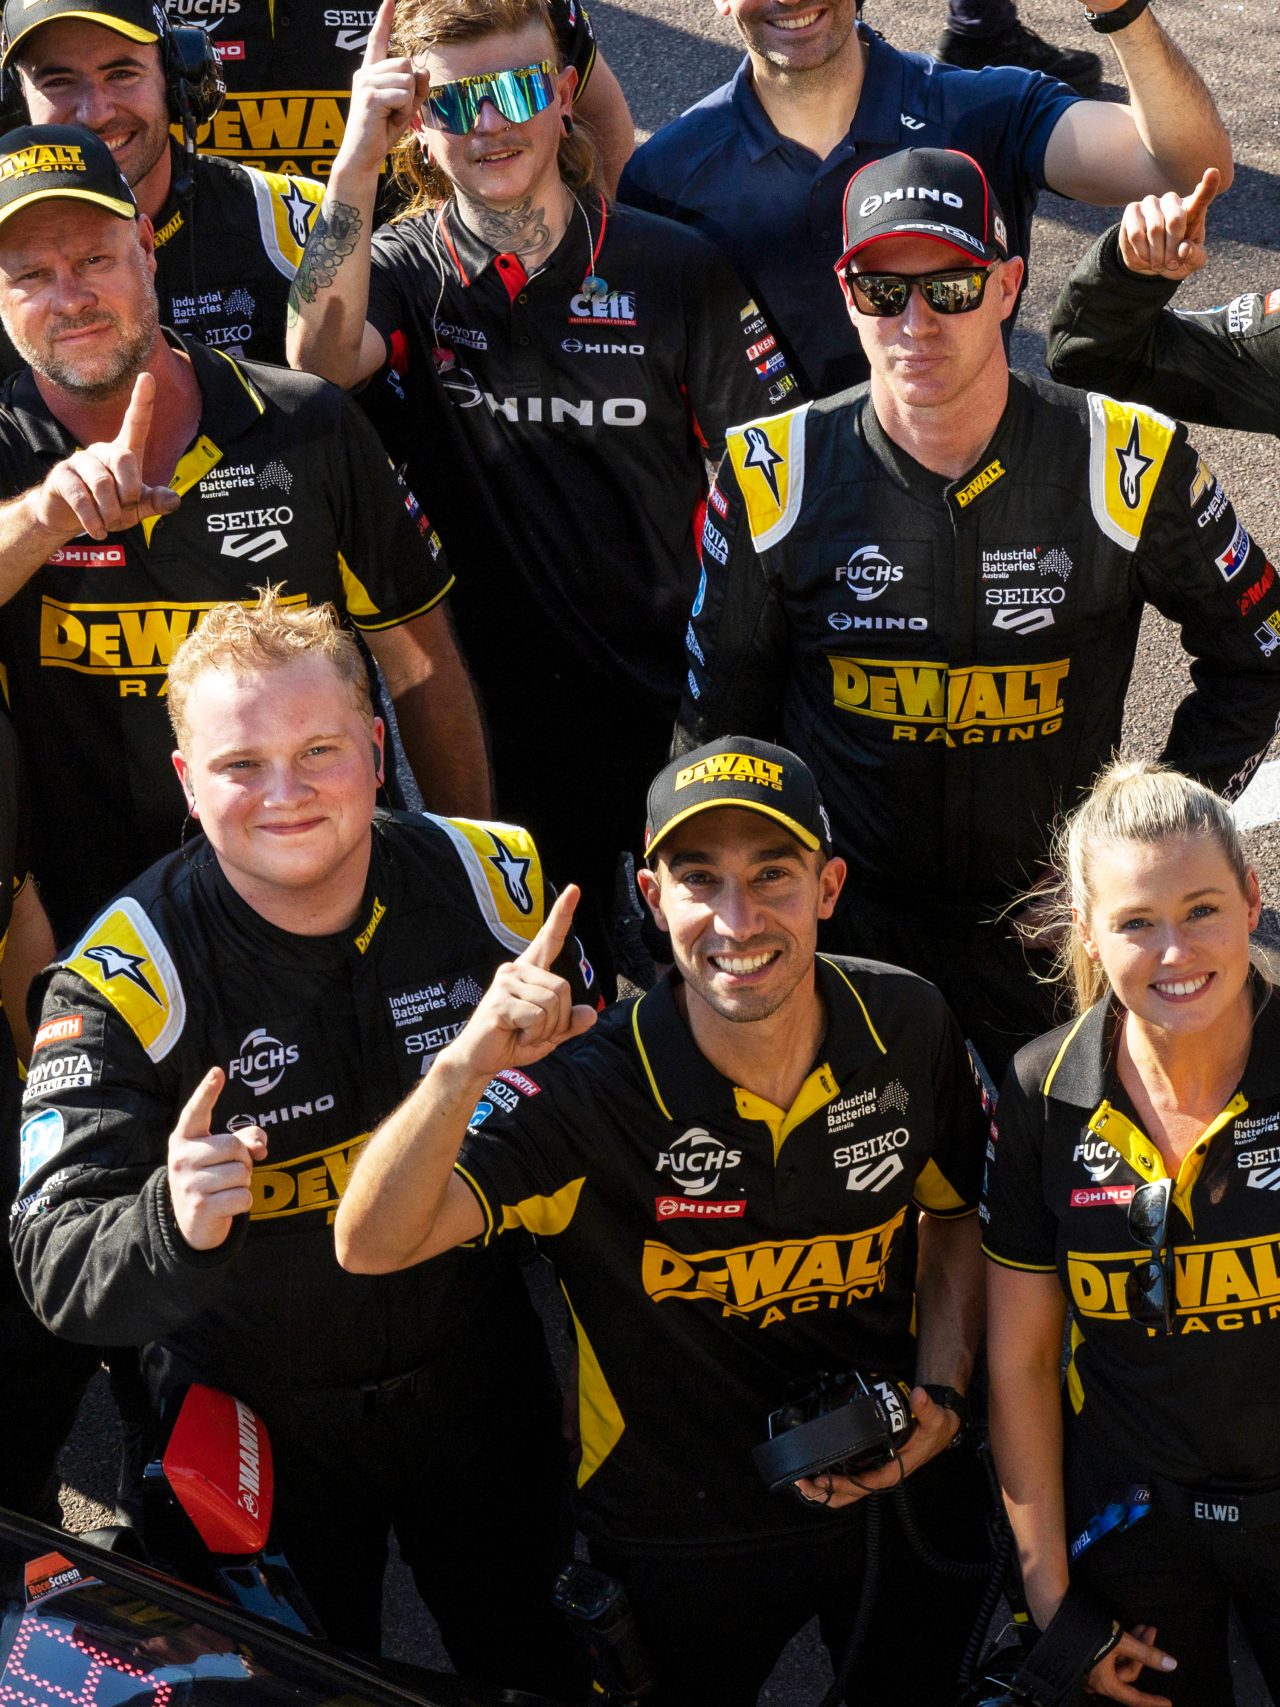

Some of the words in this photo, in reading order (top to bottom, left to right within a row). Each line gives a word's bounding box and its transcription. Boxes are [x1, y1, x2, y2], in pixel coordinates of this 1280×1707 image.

[0, 147, 81, 177] EWALT
[884, 187, 963, 208] HINO
[154, 212, 184, 248] EWALT
[186, 324, 252, 346] EIKO
[585, 344, 644, 355] HINO
[483, 392, 647, 426] HINO
[202, 464, 255, 480] ndustrial
[200, 477, 255, 493] Batteries
[201, 490, 229, 499] Australia
[207, 506, 293, 532] SEIKO
[66, 550, 121, 561] HINO
[982, 549, 1037, 561] Industrial
[835, 566, 904, 582] FUCHS
[982, 560, 1035, 571] Batteries
[985, 587, 1065, 605] SEIKO
[854, 617, 928, 631] HINO
[893, 718, 1062, 748] RACING
[704, 775, 783, 792] RACING
[389, 983, 446, 1008] Industrial
[392, 998, 447, 1019] Batteries
[27, 1054, 92, 1088] TOYOTA
[229, 1044, 299, 1079] FUCHS
[261, 1094, 334, 1127] HINO
[827, 1088, 877, 1115] Industrial
[827, 1103, 877, 1127] Batteries
[1234, 1111, 1280, 1130] Industrial
[828, 1121, 854, 1134] Australia
[1233, 1122, 1279, 1141] Batteries
[834, 1128, 909, 1168] SEIKO
[655, 1150, 742, 1172] FUCHS
[1091, 1190, 1132, 1202] HINO
[679, 1203, 741, 1214] HINO
[1194, 1503, 1239, 1522] ELWD
